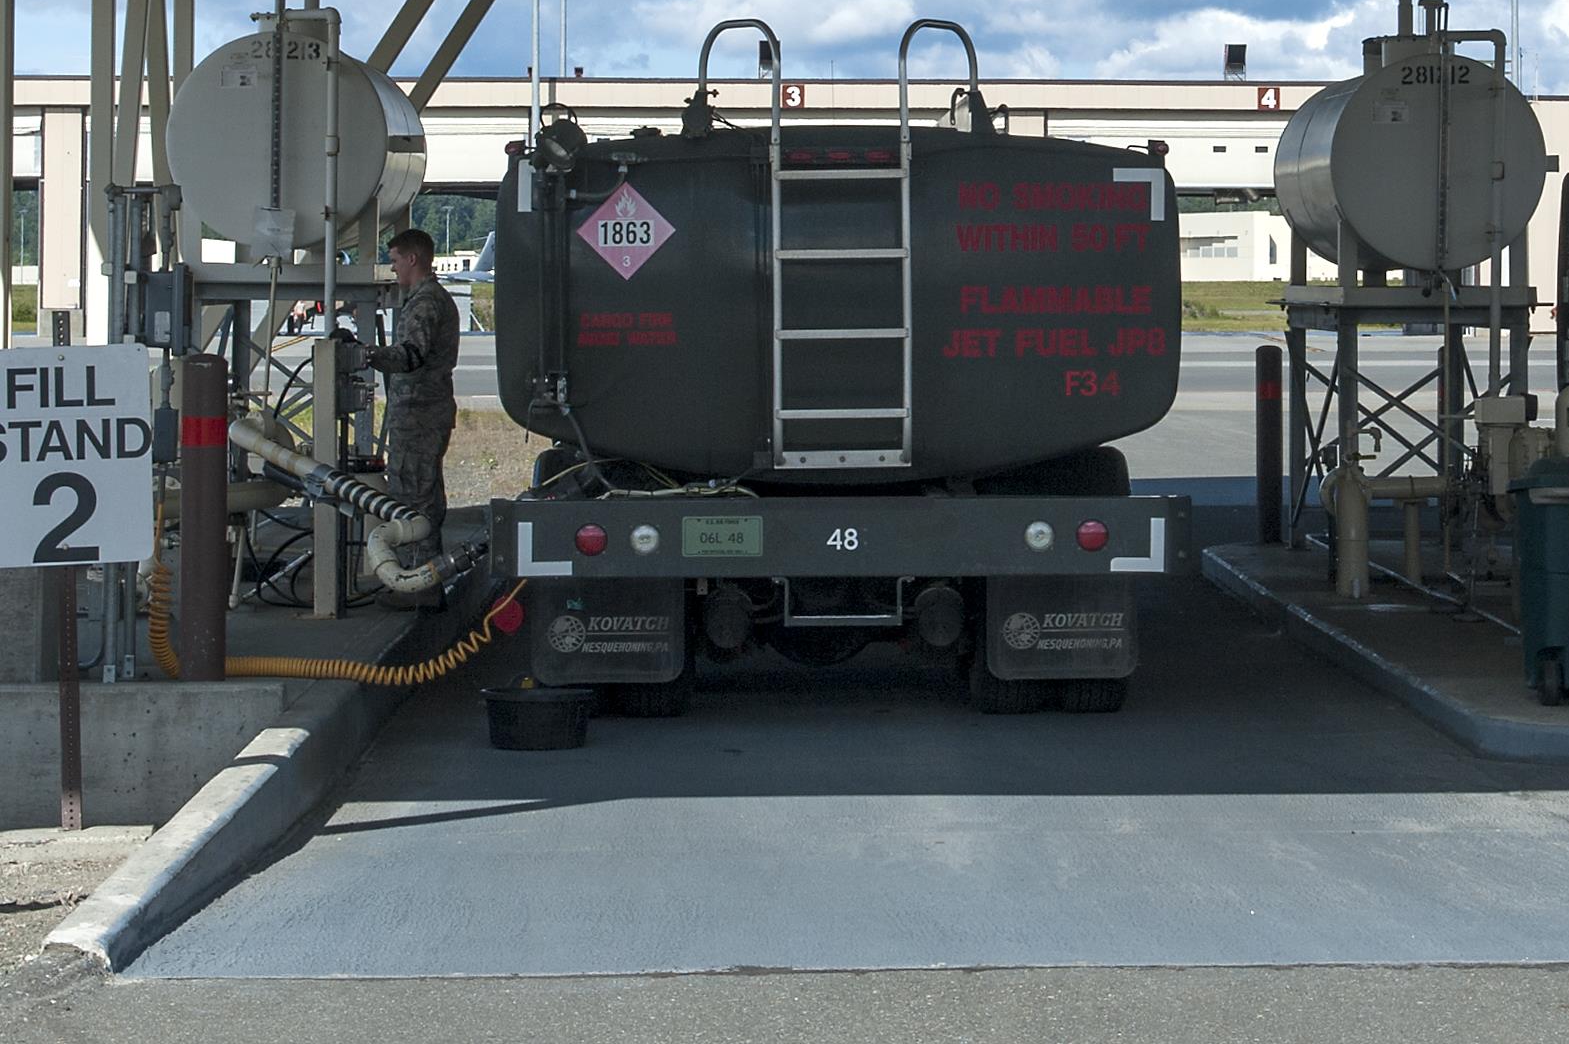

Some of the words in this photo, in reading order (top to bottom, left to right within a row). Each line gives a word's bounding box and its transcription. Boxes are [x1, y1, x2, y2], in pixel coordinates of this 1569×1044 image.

[251, 40, 320, 60] 28213
[1401, 66, 1470, 85] 28112
[785, 85, 802, 107] 3
[1260, 88, 1277, 109] 4
[958, 182, 1000, 211] NO
[1013, 182, 1148, 211] SMOKING
[600, 221, 650, 245] 1863
[956, 223, 1058, 252] WITHIN
[1071, 223, 1109, 252] 50
[1114, 223, 1151, 252] FT
[622, 255, 631, 268] 3
[960, 285, 1152, 315] FLAMMABLE
[942, 328, 1002, 358] JET
[1015, 328, 1098, 357] FUEL
[1107, 327, 1167, 356] JP8
[6, 365, 116, 409] FILL
[1064, 369, 1121, 397] F34
[0, 417, 152, 463] TAND
[32, 471, 100, 564] 2
[727, 532, 744, 544] 48
[826, 528, 859, 551] 48
[588, 616, 669, 631] KOVATCH
[1042, 612, 1124, 628] KOVATCH
